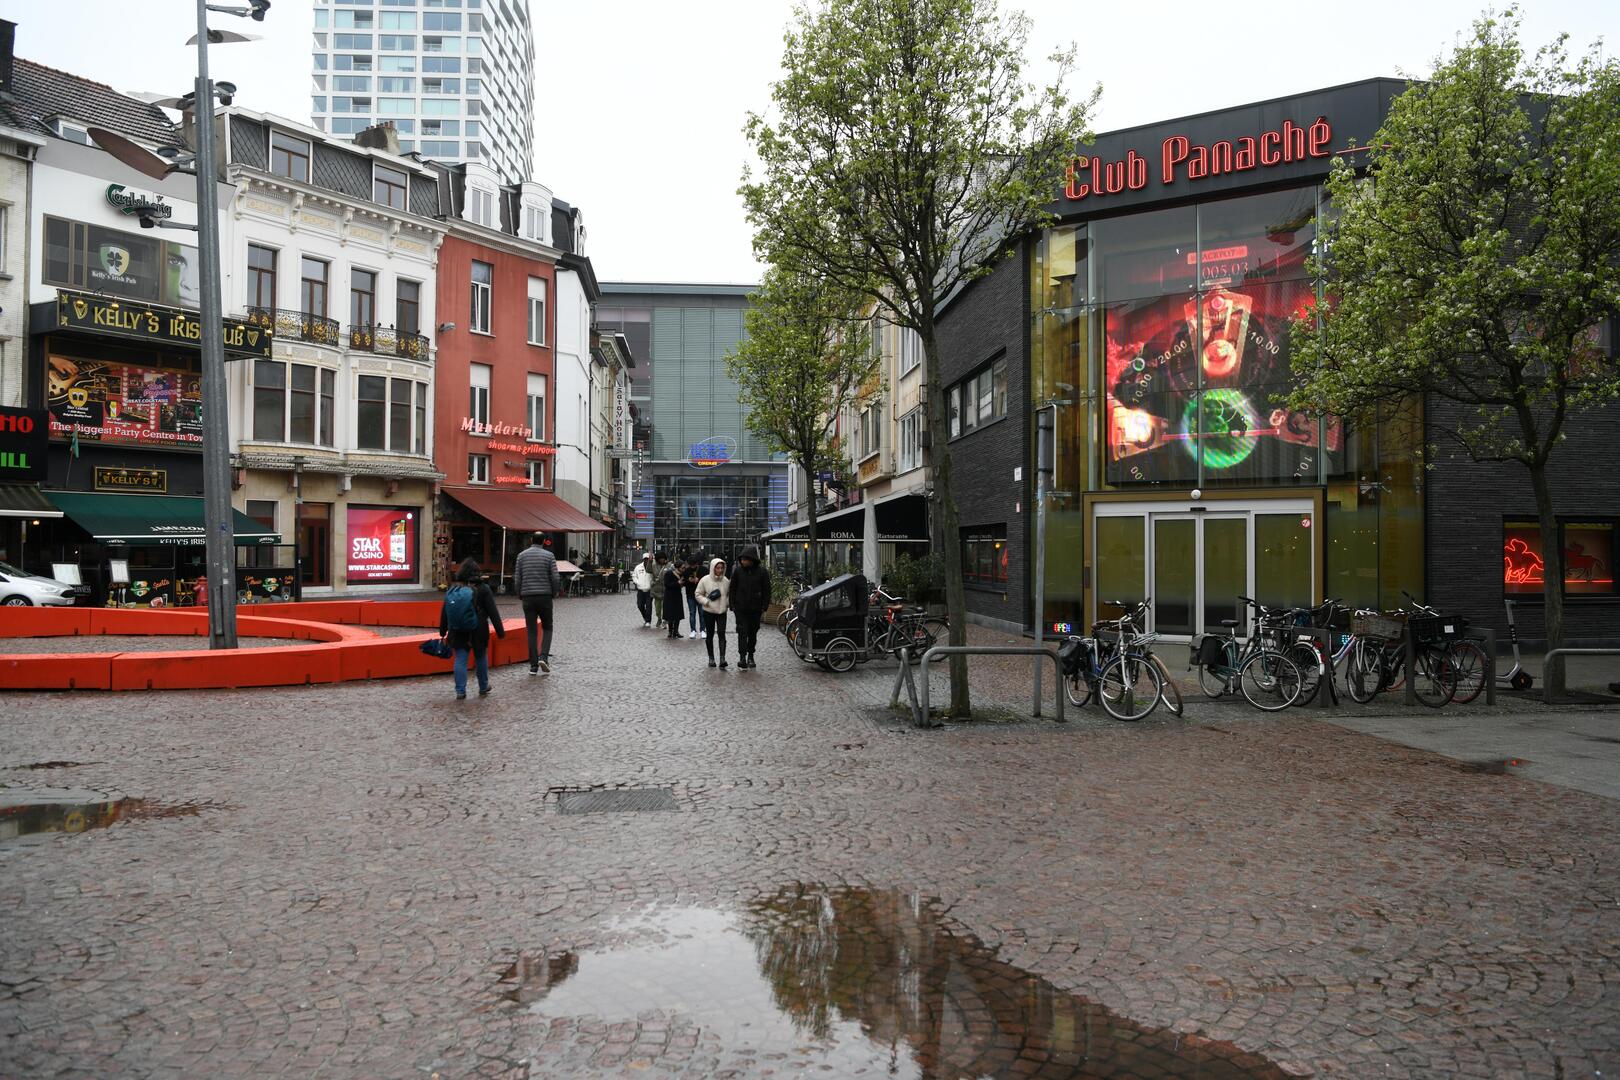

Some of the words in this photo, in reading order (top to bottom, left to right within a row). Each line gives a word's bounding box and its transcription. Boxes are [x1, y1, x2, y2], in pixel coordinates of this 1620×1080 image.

[1065, 150, 1146, 200] Club
[1162, 117, 1331, 184] Panaché
[93, 306, 160, 333] KELLY'S
[169, 319, 201, 341] IRIS
[223, 326, 245, 346] UB
[1158, 340, 1188, 365] 20.00
[1250, 331, 1280, 355] 10.00
[1132, 373, 1153, 403] 10.00
[51, 421, 72, 432] The
[74, 424, 112, 435] Biggest
[114, 426, 140, 438] Party
[142, 429, 175, 440] Centre
[176, 432, 186, 440] in
[460, 417, 533, 438] Mandarin
[111, 475, 150, 486] KELLY'S
[352, 538, 382, 552] STAR
[830, 531, 855, 540] ROMA
[352, 551, 384, 560] CASINO
[1053, 623, 1071, 633] OPEN
